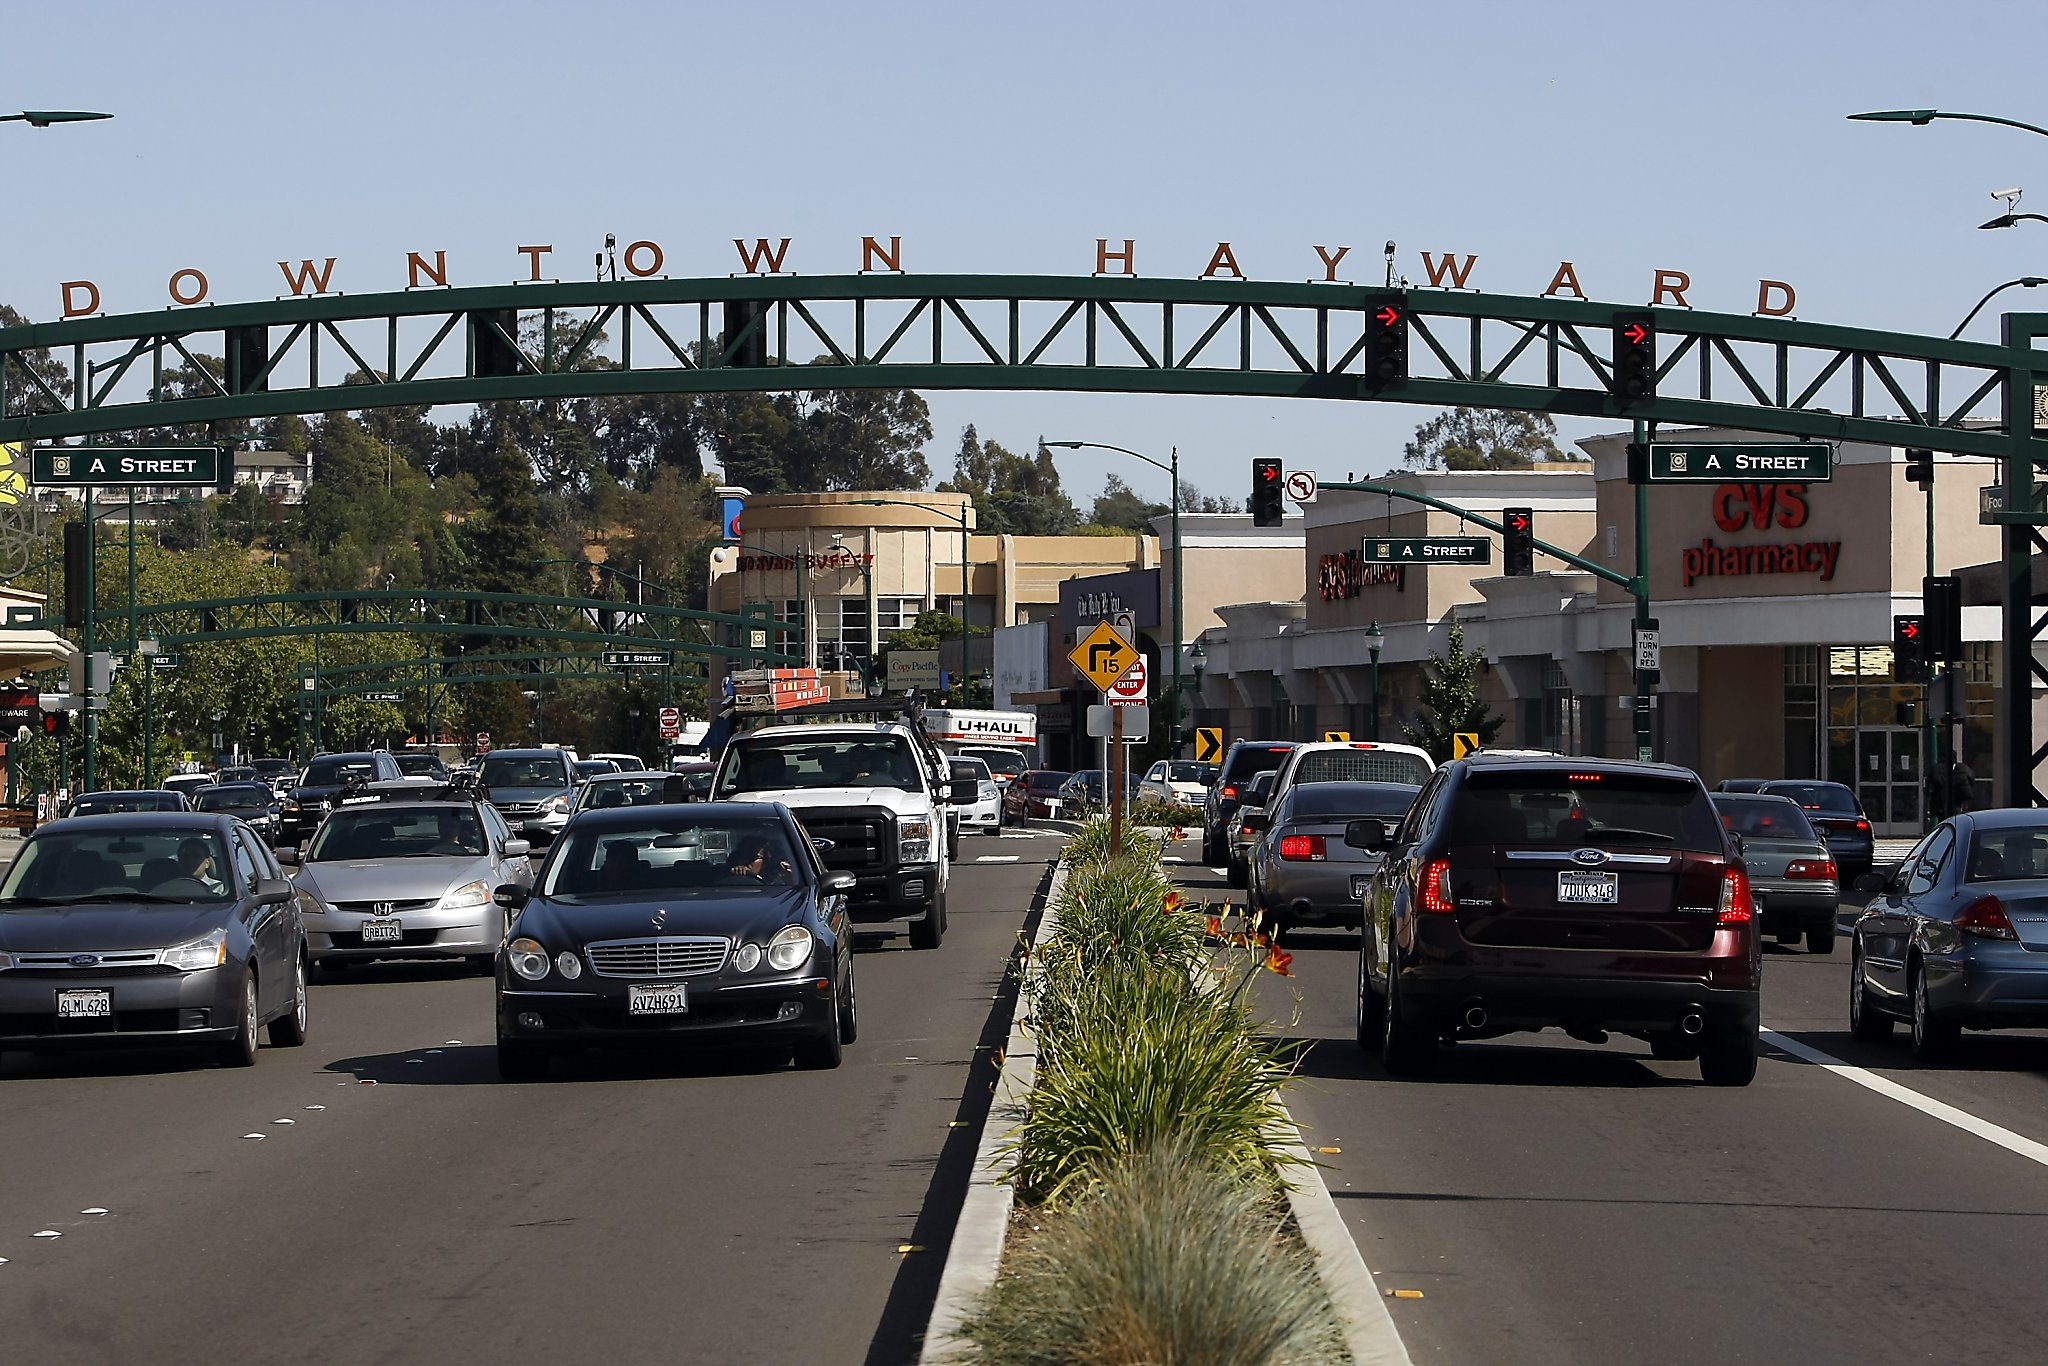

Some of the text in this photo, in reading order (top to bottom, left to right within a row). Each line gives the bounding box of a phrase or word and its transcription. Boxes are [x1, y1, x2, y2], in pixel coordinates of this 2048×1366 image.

[60, 236, 1797, 317] DOWNTOWN HAYWARD
[89, 458, 197, 473] A STREET
[1705, 455, 1809, 470] A STREET
[1712, 483, 1809, 533] CVS
[1402, 545, 1475, 556] A STREET
[805, 552, 874, 571] BUFFET
[1683, 538, 1842, 588] pharmacy
[1643, 633, 1654, 641] NO
[1639, 642, 1658, 650] TURN
[1642, 651, 1653, 659] ON
[1102, 659, 1120, 674] 15
[1640, 659, 1656, 667] RED
[1117, 681, 1138, 689] ENTER
[0, 709, 29, 717] DWARE
[958, 720, 1023, 734] U-HAUL
[1580, 851, 1599, 860] Ford
[1561, 883, 1614, 898] 7DUK348
[61, 998, 108, 1014] 6LML628
[633, 994, 684, 1010] 6VZH691
